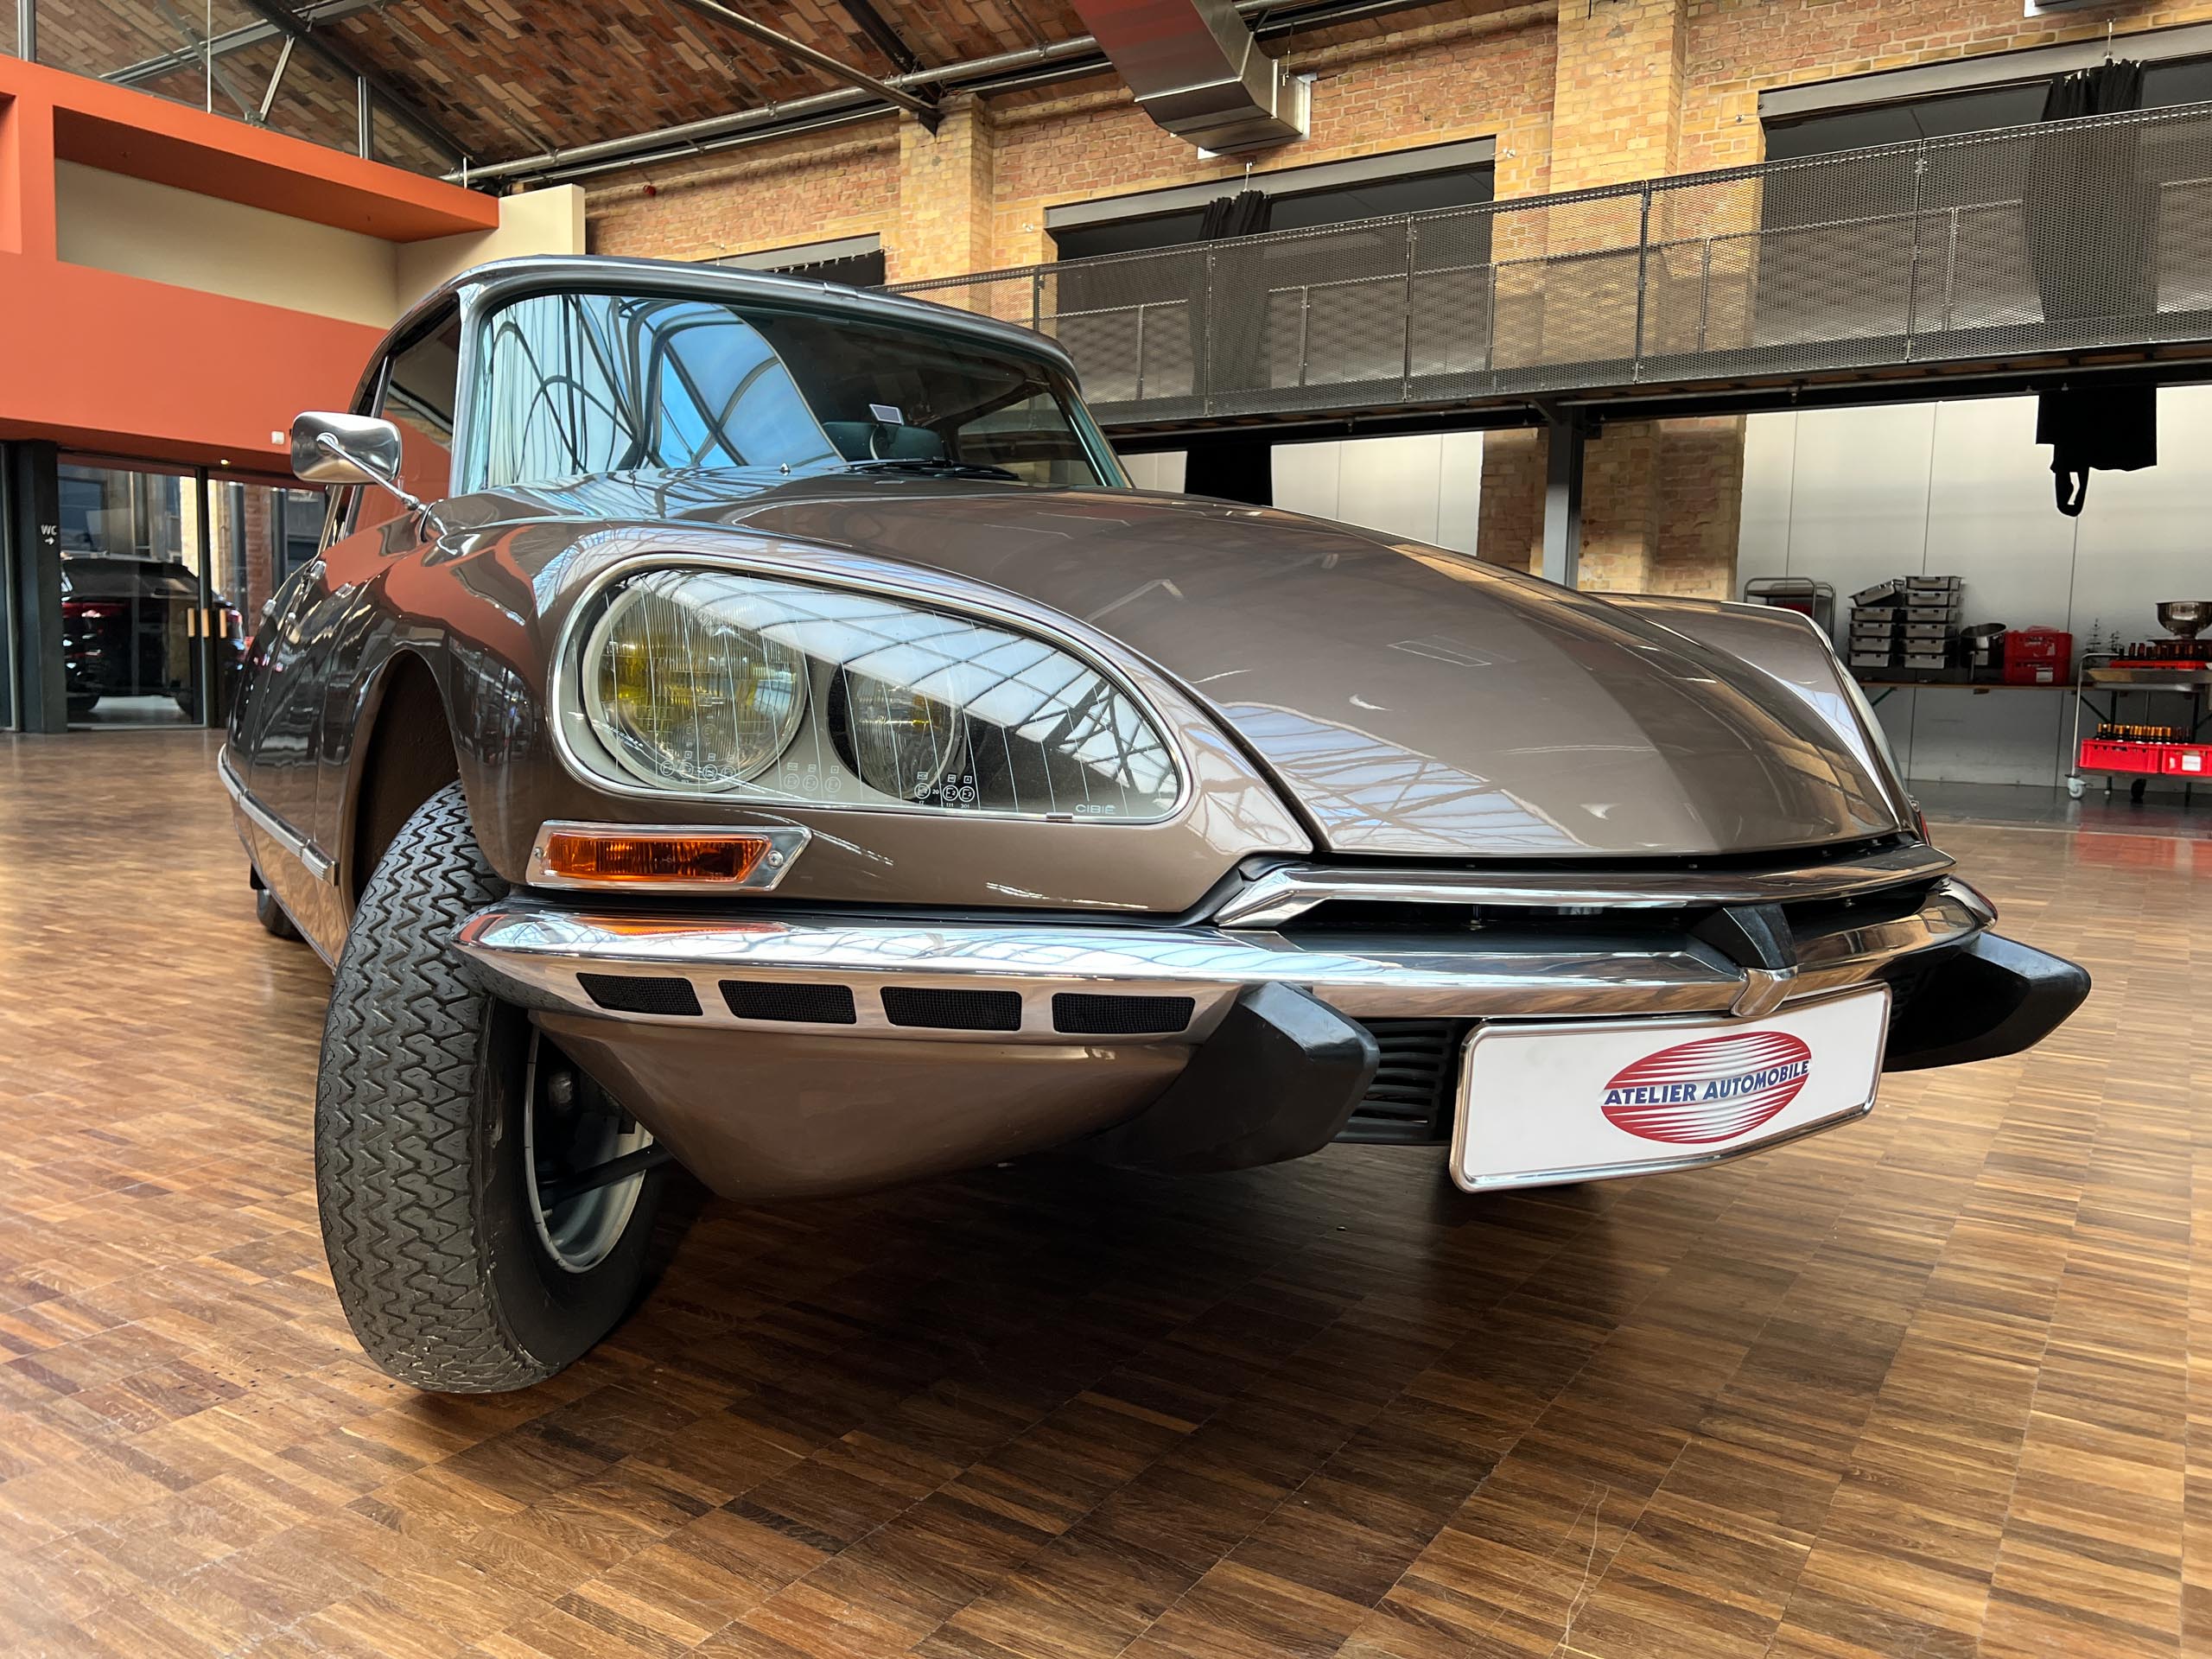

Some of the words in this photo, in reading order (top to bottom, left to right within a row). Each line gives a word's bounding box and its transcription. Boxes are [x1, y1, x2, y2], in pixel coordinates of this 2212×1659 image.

[41, 524, 57, 536] WC
[1604, 1083, 1697, 1105] ATELIER
[1702, 1060, 1809, 1100] AUTOMOBILE
